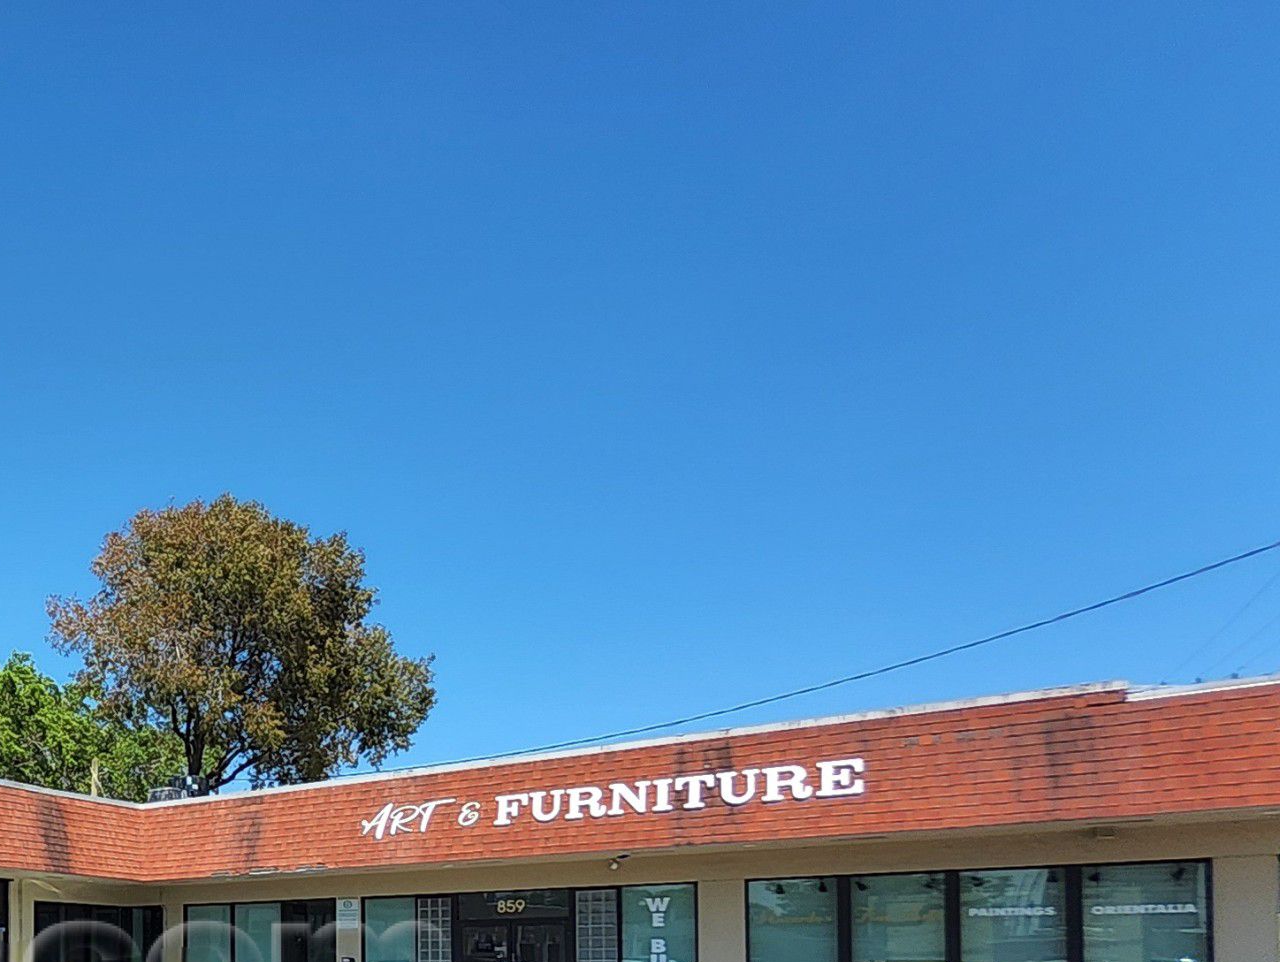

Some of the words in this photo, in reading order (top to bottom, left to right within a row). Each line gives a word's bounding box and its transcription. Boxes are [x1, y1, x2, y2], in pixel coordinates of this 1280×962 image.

[361, 798, 456, 840] ART
[458, 801, 480, 827] &
[493, 757, 866, 827] FURNITURE
[497, 899, 526, 913] 859
[645, 897, 670, 927] WE
[968, 906, 1057, 917] PAINTINGS
[1090, 903, 1198, 915] ORIENTALIA
